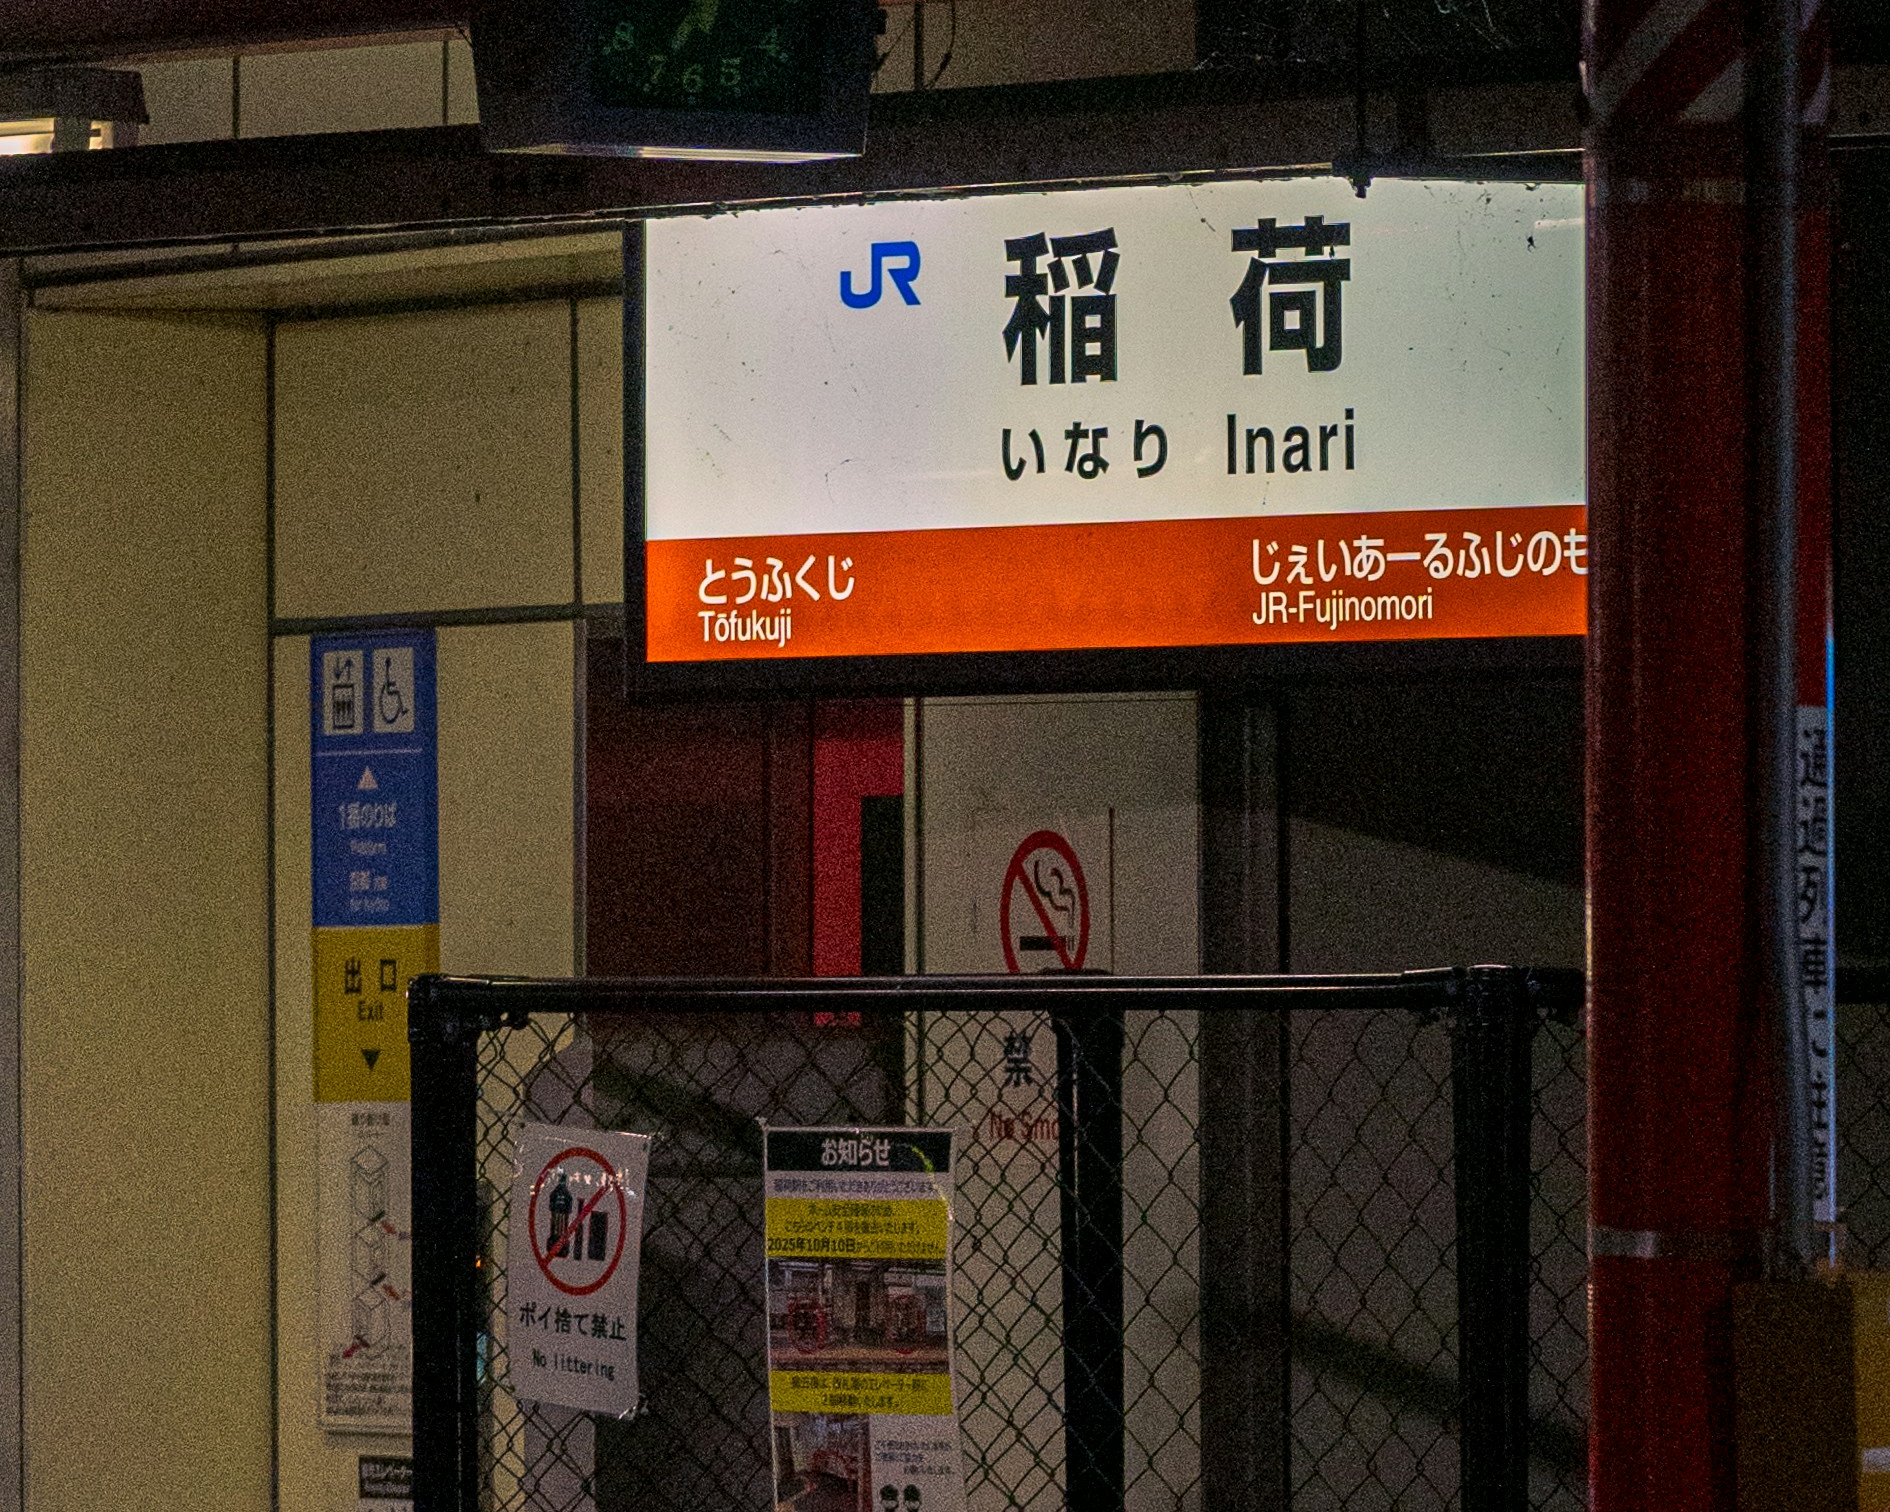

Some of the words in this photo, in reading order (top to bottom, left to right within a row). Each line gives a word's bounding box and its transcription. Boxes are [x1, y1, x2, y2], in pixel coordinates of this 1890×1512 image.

[612, 21, 634, 50] 8
[758, 26, 780, 57] 4
[682, 64, 703, 92] 6
[719, 57, 741, 85] 5
[840, 240, 920, 309] JR
[1002, 216, 1351, 386] 稲荷
[1002, 419, 1168, 481] いなり
[1227, 409, 1355, 474] Inari
[698, 555, 856, 605] とうふくじ
[698, 609, 793, 649] Tōfukuji
[1253, 588, 1434, 633] JR-Fujinomori
[344, 958, 397, 994] 出口
[358, 1000, 384, 1022] Exit
[821, 1138, 891, 1166] お知らせ
[519, 1303, 627, 1343] ポイ捨て禁止
[555, 1353, 616, 1382] littering
